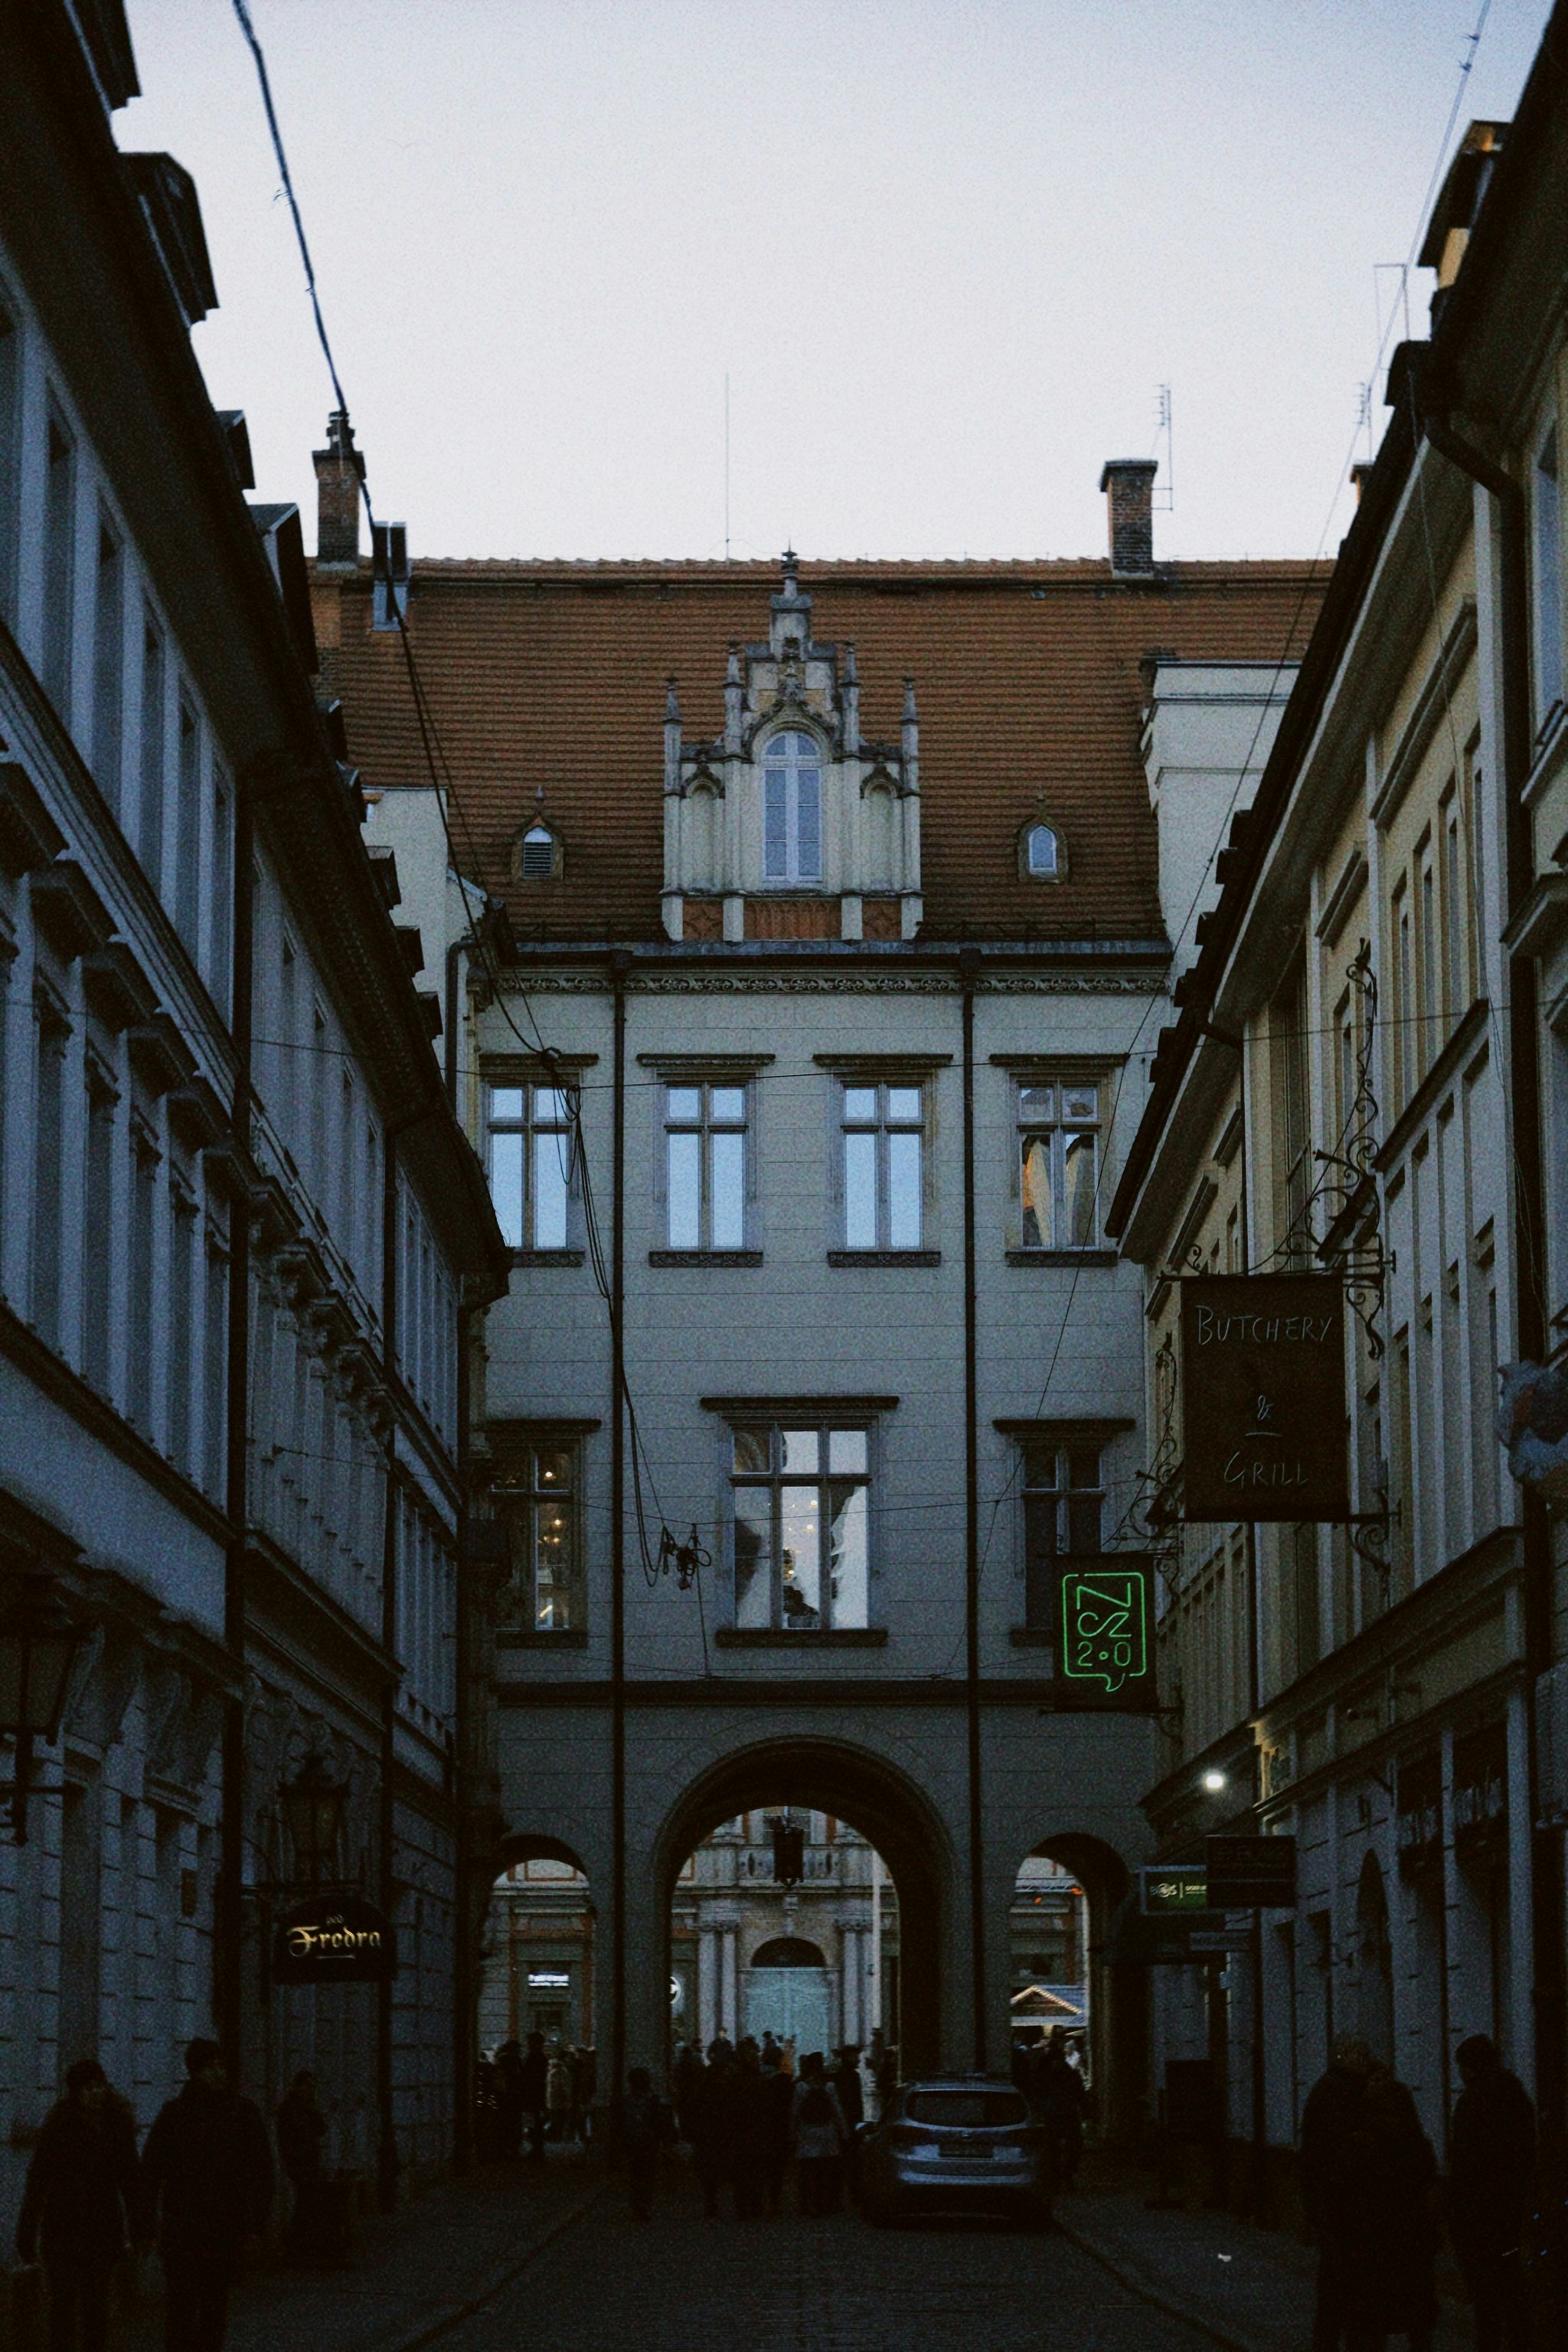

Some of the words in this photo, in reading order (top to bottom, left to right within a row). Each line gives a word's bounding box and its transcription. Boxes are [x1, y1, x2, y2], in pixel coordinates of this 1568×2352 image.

[1195, 1305, 1333, 1346] BUTCHERY
[1257, 1394, 1274, 1421] &
[1223, 1452, 1309, 1489] GRILL
